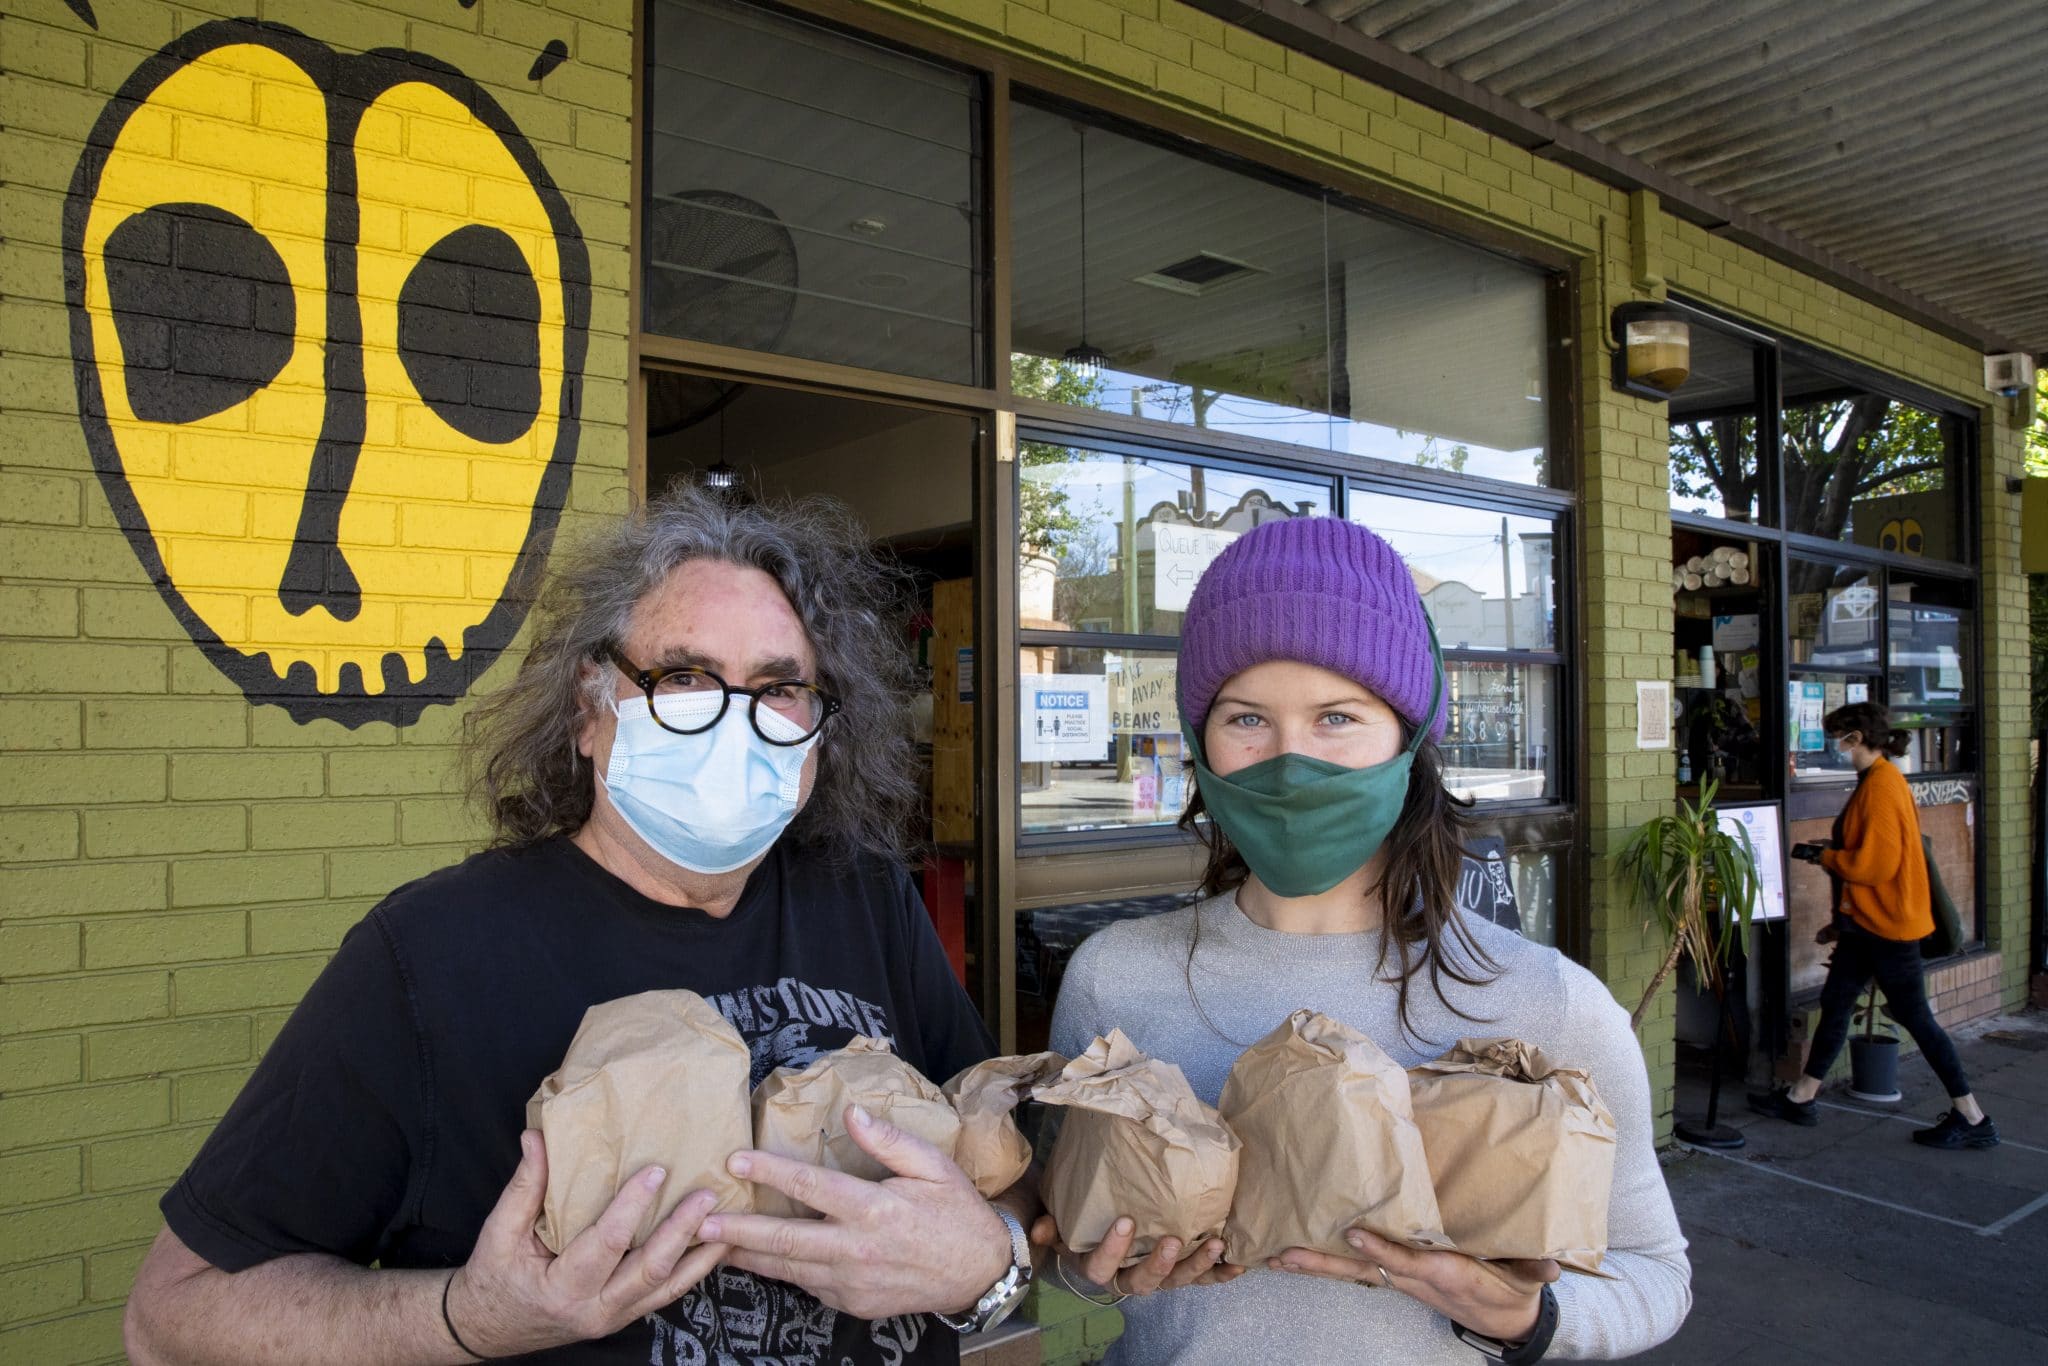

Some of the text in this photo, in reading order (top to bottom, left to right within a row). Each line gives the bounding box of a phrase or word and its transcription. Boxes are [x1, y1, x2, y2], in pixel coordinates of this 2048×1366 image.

[1160, 528, 1199, 554] QUEUE
[1040, 694, 1084, 707] NOTICE
[1132, 678, 1163, 706] AWAY
[1113, 711, 1161, 729] BEANS
